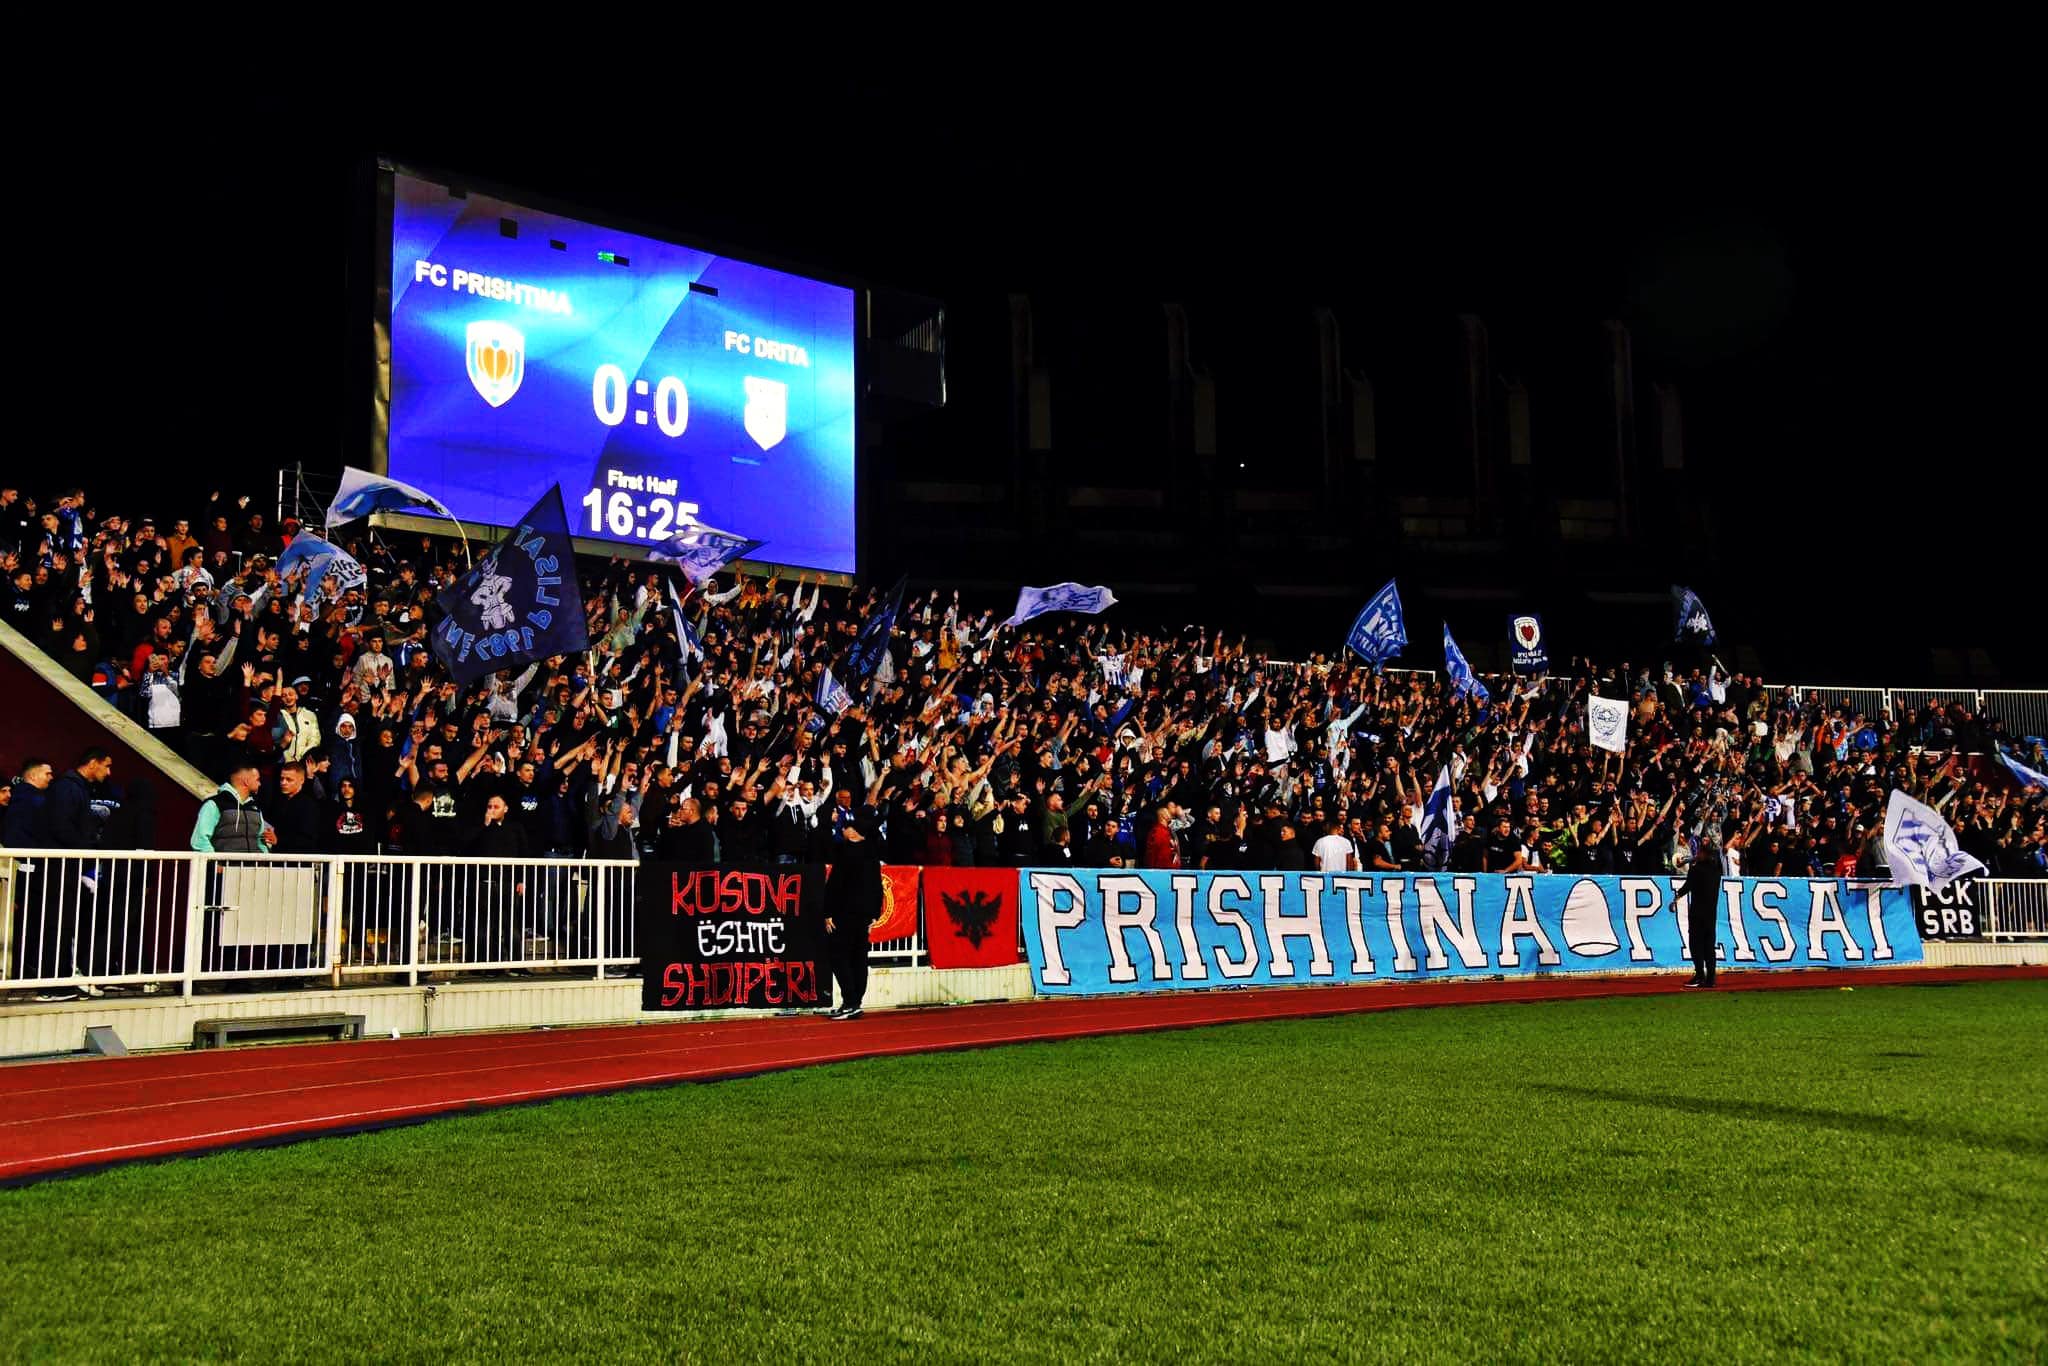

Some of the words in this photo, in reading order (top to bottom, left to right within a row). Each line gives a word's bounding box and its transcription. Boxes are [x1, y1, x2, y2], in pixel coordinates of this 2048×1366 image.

[415, 260, 448, 287] FC
[453, 268, 573, 316] PRISHTINA
[724, 329, 751, 354] FC
[754, 337, 809, 368] DRITA
[592, 363, 689, 438] 0:0
[607, 469, 644, 491] First
[646, 475, 679, 496] Half
[583, 488, 699, 545] 16:25
[671, 870, 802, 917] KOSOVA
[697, 917, 786, 957] ËSHTË
[1029, 872, 1561, 986] PRISHTINA
[1923, 908, 1975, 935] SRB
[661, 957, 818, 1007] SHQIPËRI
